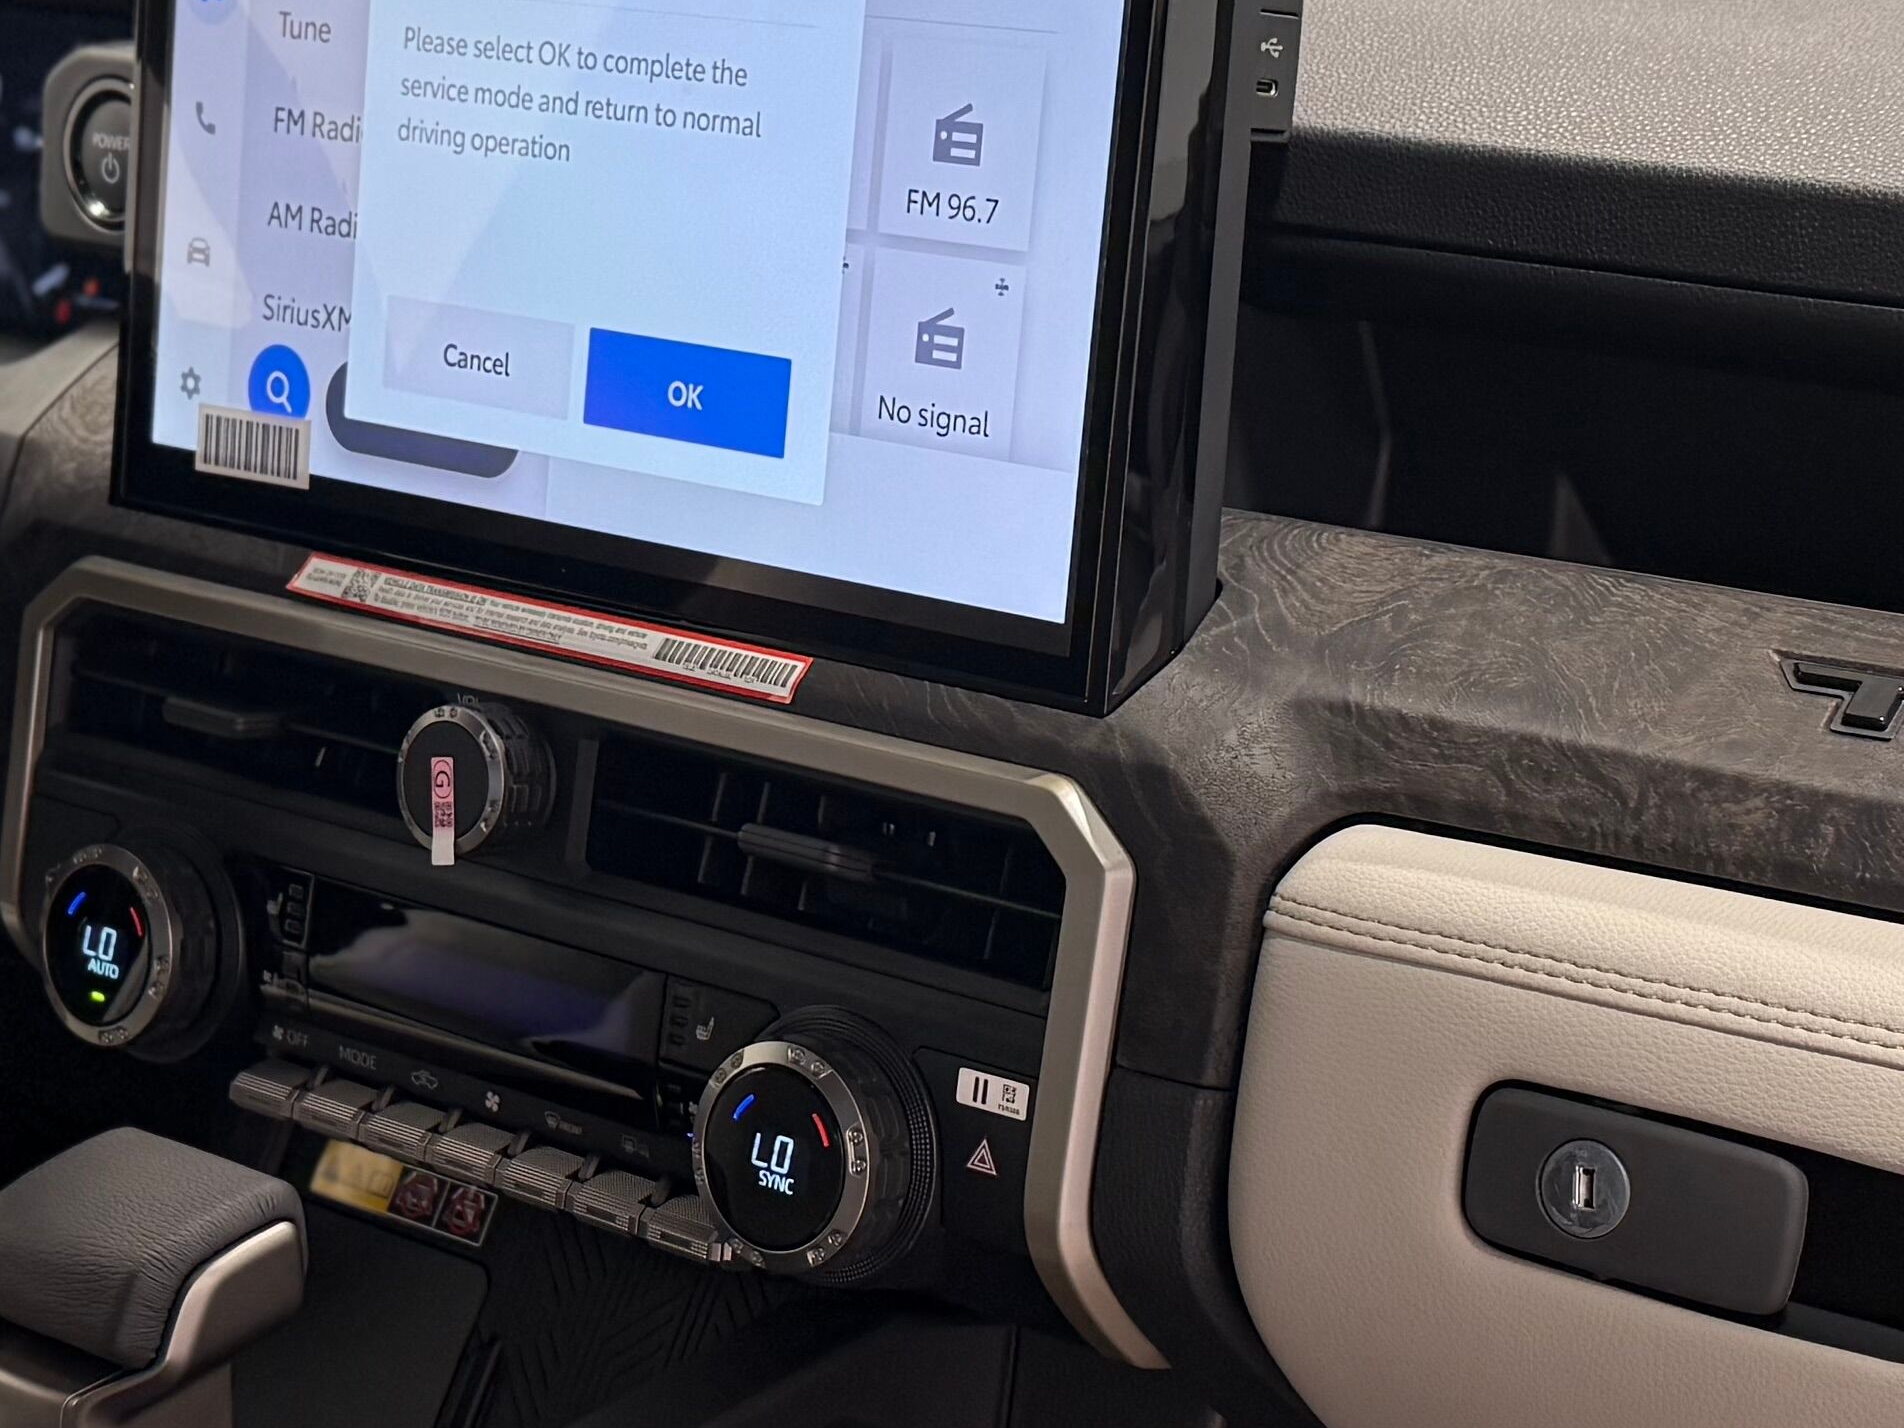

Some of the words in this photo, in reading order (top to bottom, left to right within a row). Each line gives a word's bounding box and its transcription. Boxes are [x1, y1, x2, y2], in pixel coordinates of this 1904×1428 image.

[279, 11, 332, 43] Tune
[404, 26, 468, 57] Please
[473, 36, 533, 64] select
[538, 40, 571, 68] OK
[577, 47, 597, 71] to
[603, 52, 706, 83] complete
[712, 59, 748, 86] the
[401, 75, 469, 103] service
[474, 85, 533, 111] mode
[538, 90, 579, 117] and
[585, 97, 648, 124] return
[655, 103, 677, 128] to
[683, 109, 761, 138] normal
[274, 106, 305, 136] FM
[312, 111, 363, 144] Radi
[398, 117, 465, 155] driving
[471, 130, 570, 162] operation
[267, 201, 304, 230] AM
[906, 188, 941, 217] FM
[948, 193, 1000, 224] 96.7
[443, 344, 510, 377] Cancel
[667, 380, 704, 411] OK
[878, 395, 911, 424] No
[918, 403, 990, 438] signal
[88, 957, 119, 979] AUTO
[286, 1030, 309, 1047] OFF
[339, 1045, 377, 1070] MODE
[758, 1170, 794, 1195] SYNC
